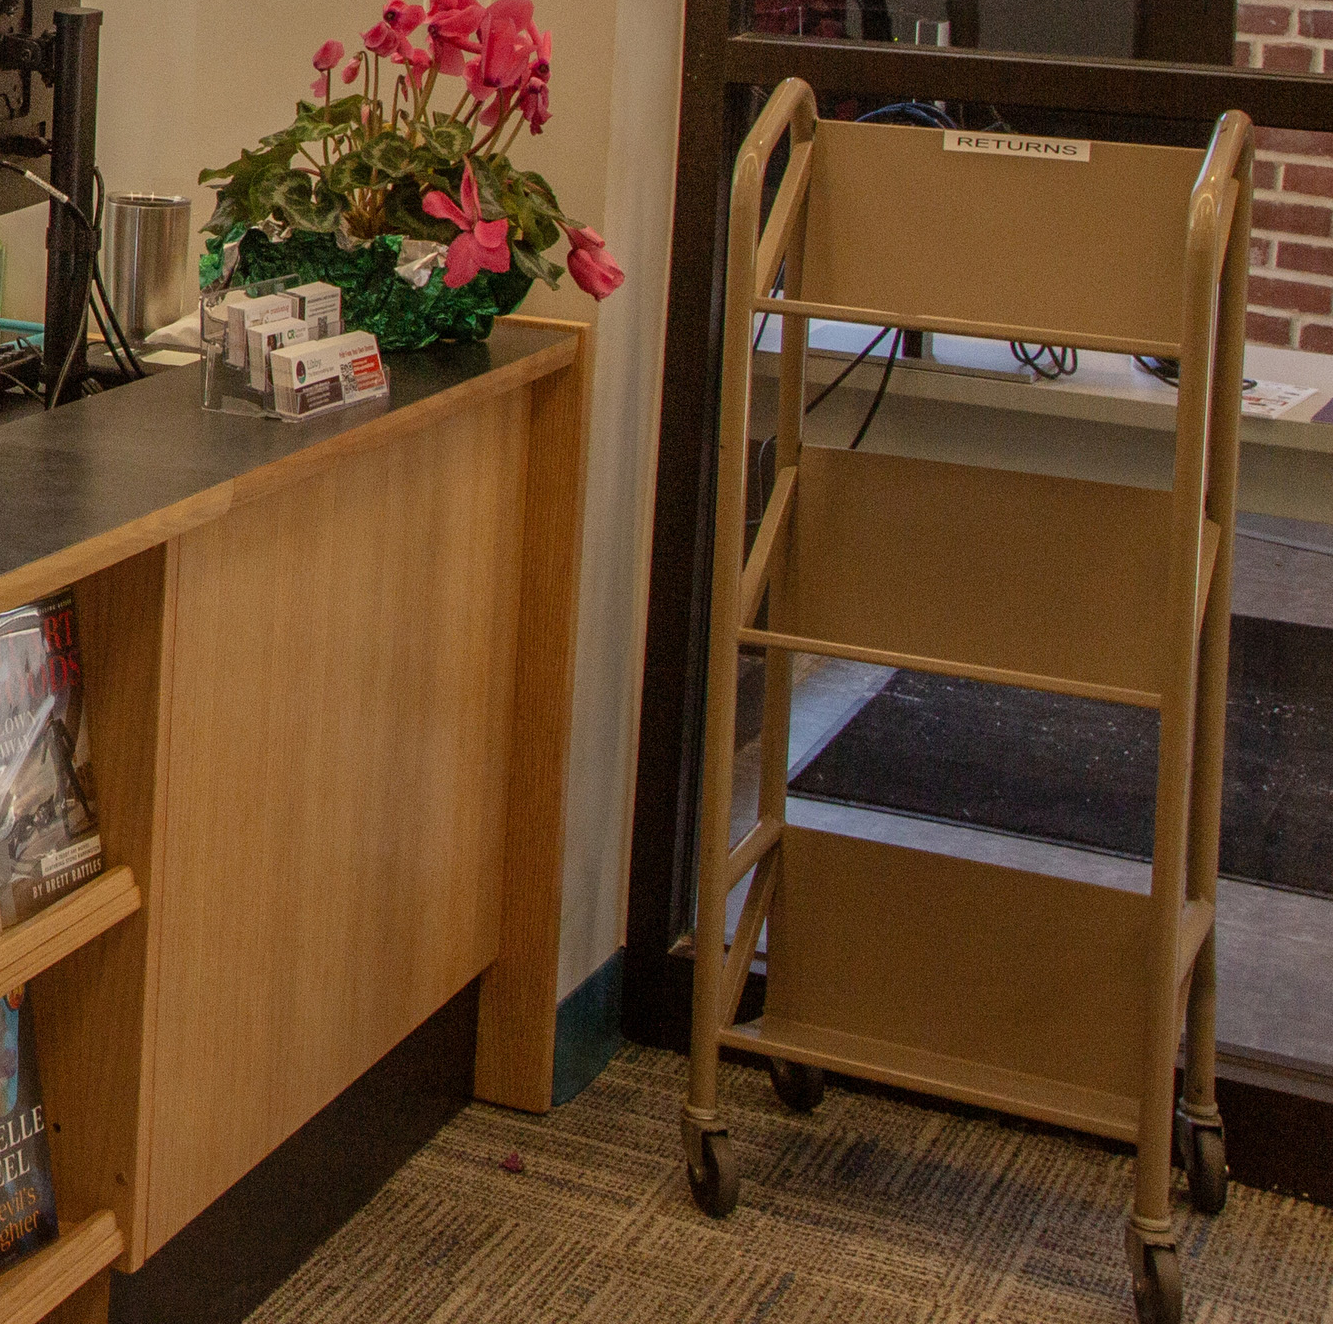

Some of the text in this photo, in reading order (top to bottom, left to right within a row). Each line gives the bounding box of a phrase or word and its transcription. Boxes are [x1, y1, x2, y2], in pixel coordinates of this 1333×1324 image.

[956, 135, 1078, 157] RETURNS
[33, 858, 102, 899] BY BRETT BATTLES
